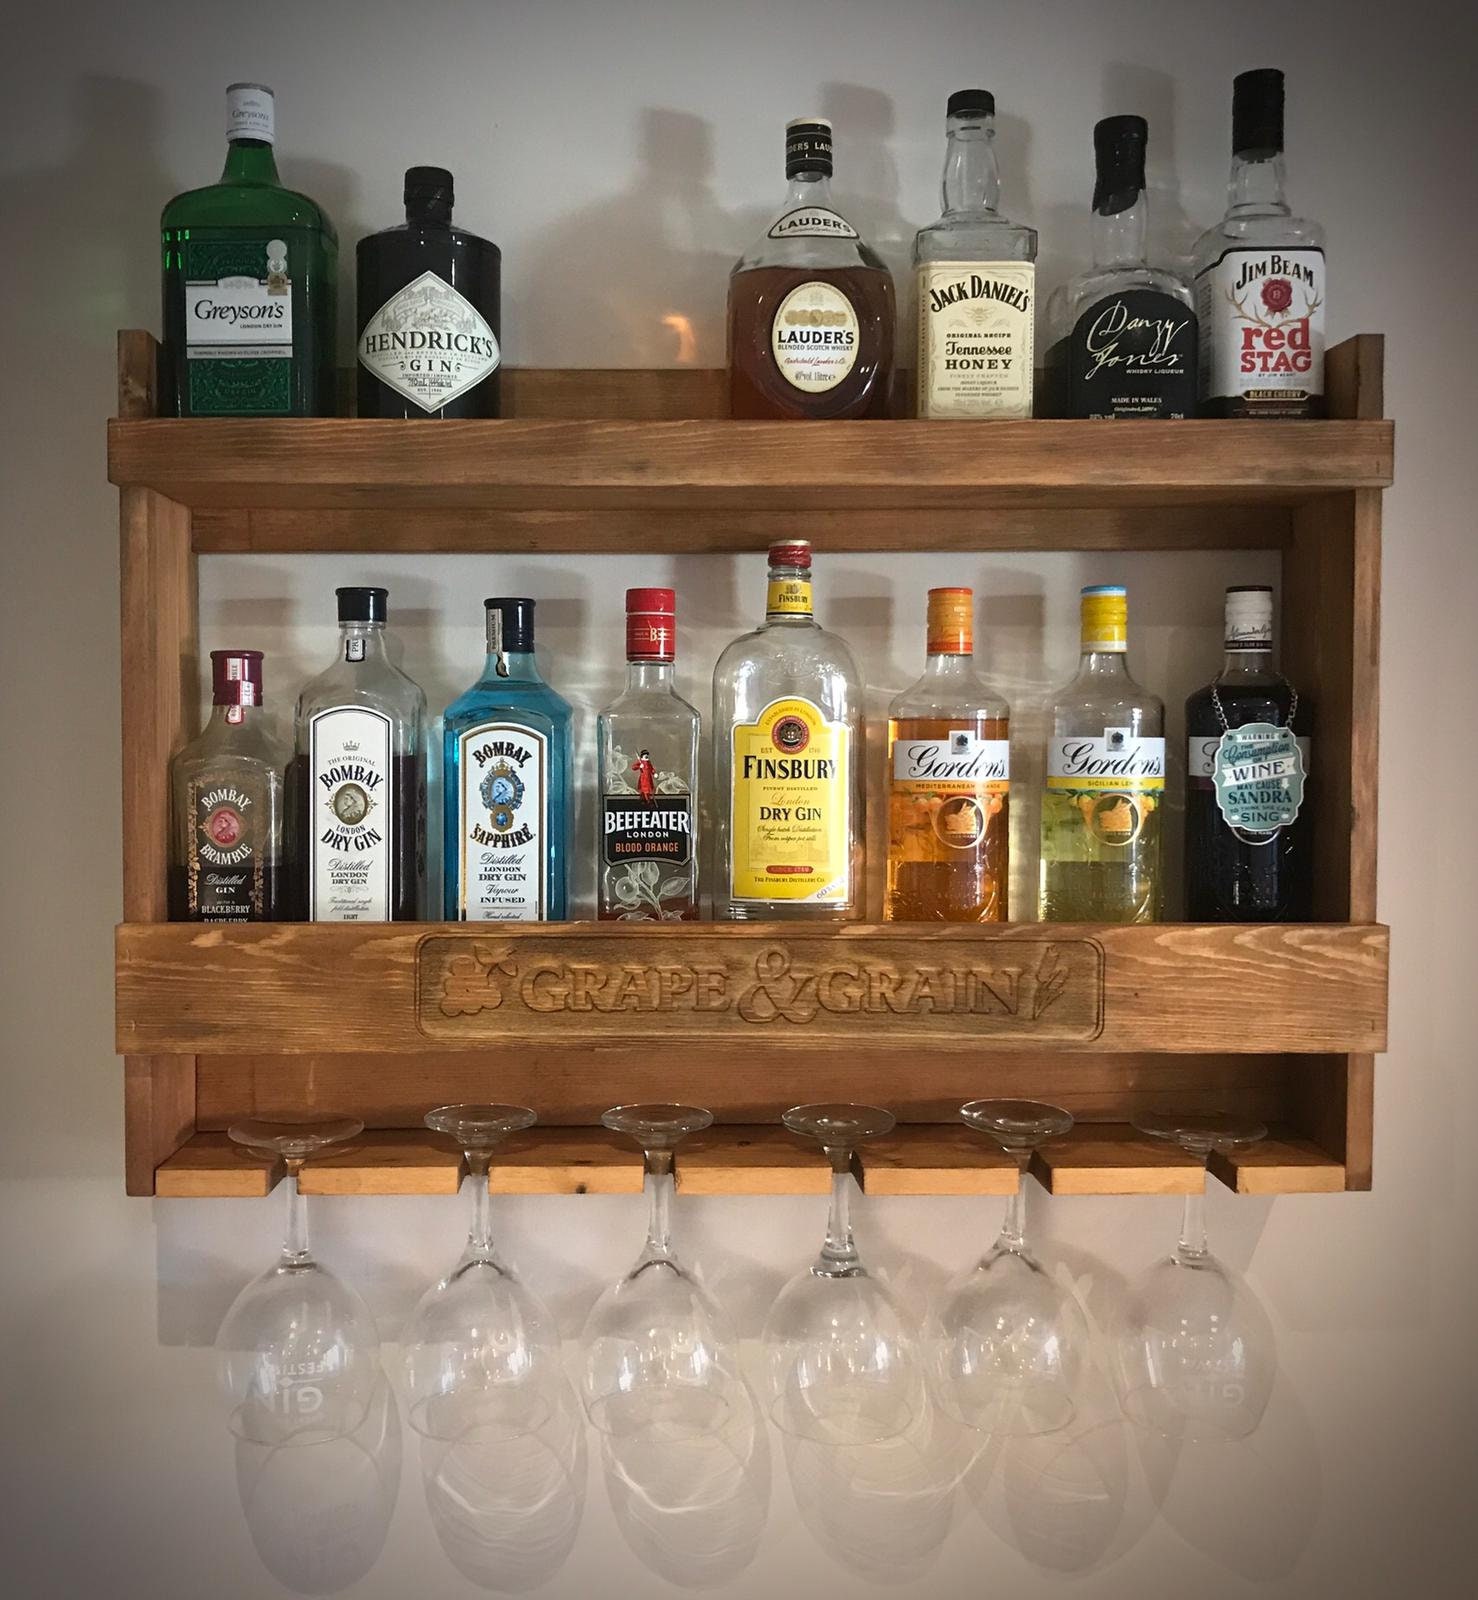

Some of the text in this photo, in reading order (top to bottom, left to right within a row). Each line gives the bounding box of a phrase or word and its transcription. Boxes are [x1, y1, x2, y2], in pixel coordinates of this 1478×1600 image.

[814, 142, 832, 153] LAU
[1236, 255, 1314, 289] JIM BEAM
[929, 275, 1031, 312] JACK DANIEL'S
[194, 299, 284, 325] Greyson's
[777, 330, 854, 344] LAUDER'S
[1241, 318, 1312, 350] red
[365, 331, 493, 358] HENDRICK'S
[946, 341, 1012, 356] Tennessee
[410, 359, 452, 372] GIN
[945, 359, 1013, 370] HONEY
[1241, 351, 1312, 373] STAG
[342, 756, 376, 767] ORIGINAL
[472, 741, 533, 768] BOMBAY
[743, 755, 837, 779] FINSBURY
[1232, 761, 1286, 781] WINE
[319, 765, 384, 792] BOMBAY
[1256, 780, 1280, 790] CAUSE
[201, 788, 252, 812] BOMBAY
[1228, 790, 1293, 805] SANDRA
[604, 811, 690, 834] BEEFEATER
[760, 806, 822, 821] DRY GIN
[1241, 811, 1280, 822] SING
[336, 824, 366, 834] LONDON
[470, 822, 534, 849] SAPPHIRE
[321, 828, 382, 852] DRY GIN
[615, 842, 679, 852] BLOOD ORANGE
[200, 843, 253, 865] BRAMBLE
[479, 852, 526, 865] Distilled
[478, 873, 527, 881] DRY GIN
[201, 905, 251, 914] BLACKBERRY
[520, 943, 1024, 1025] GRAPE & GRAIN
